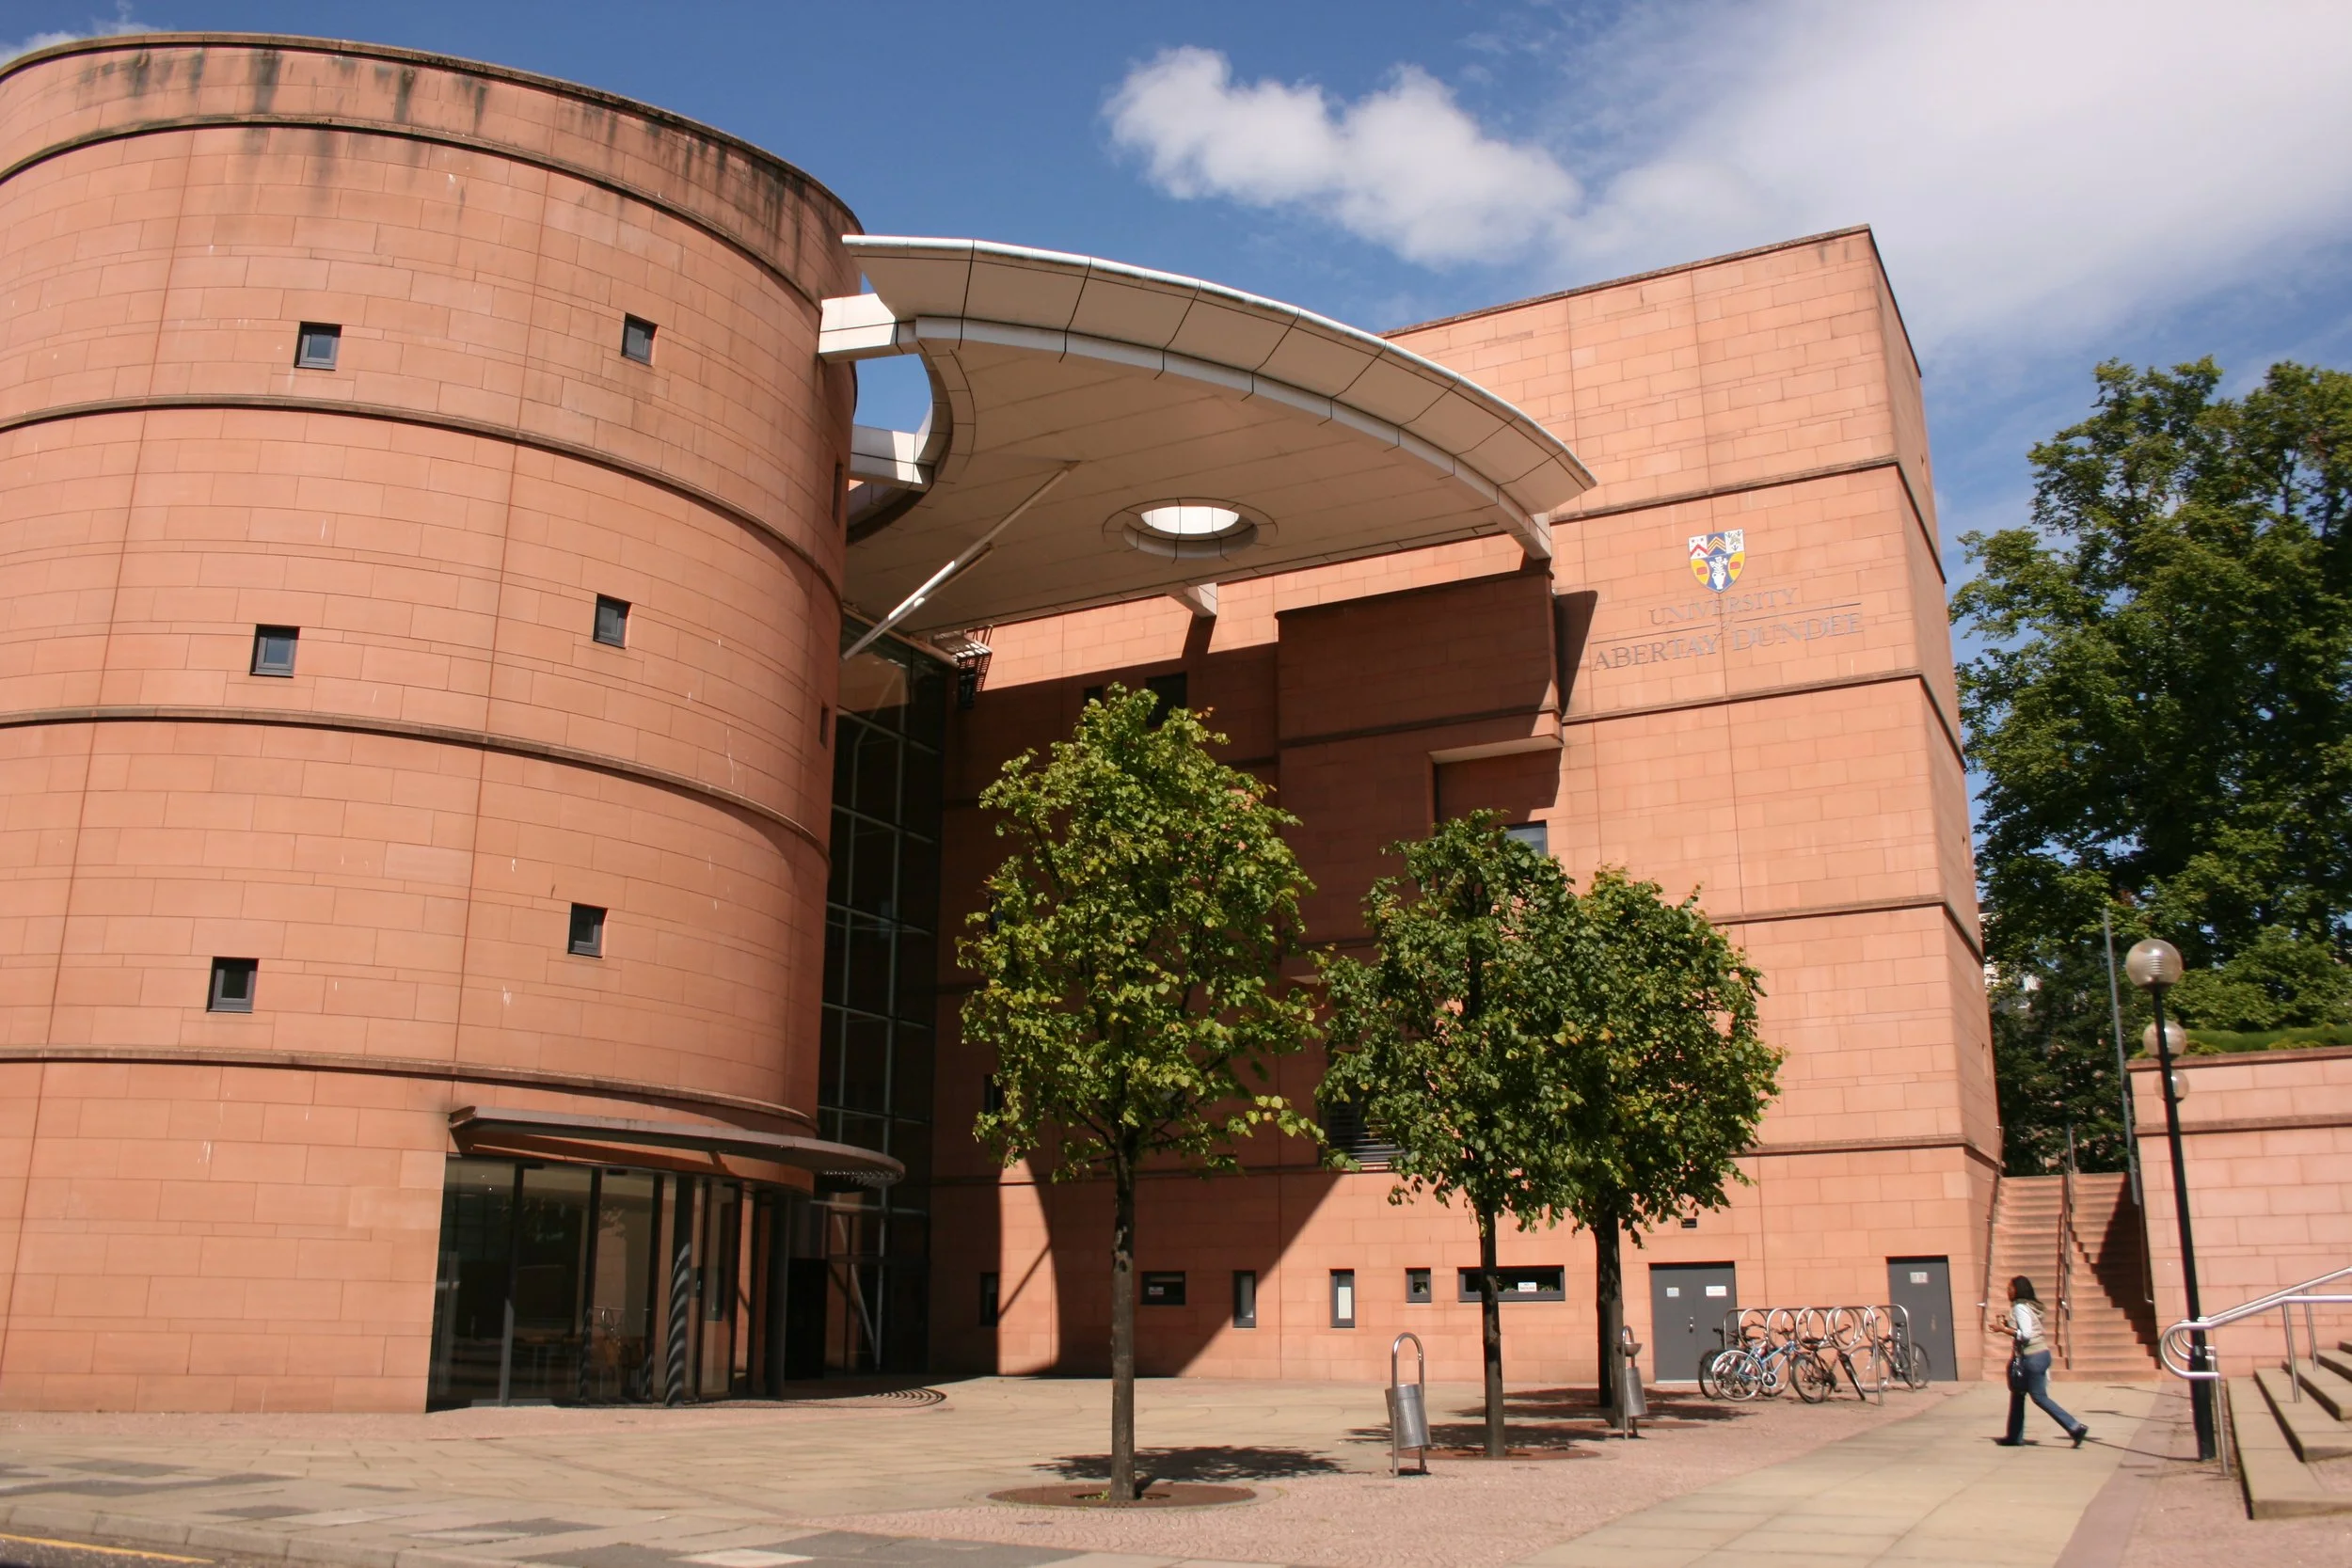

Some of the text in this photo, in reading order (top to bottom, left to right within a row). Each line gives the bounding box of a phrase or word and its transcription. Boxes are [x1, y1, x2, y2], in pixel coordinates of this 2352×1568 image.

[1648, 587, 1798, 626] UNIVERSITY
[1591, 612, 1864, 671] ABERTAY DUNDEE
